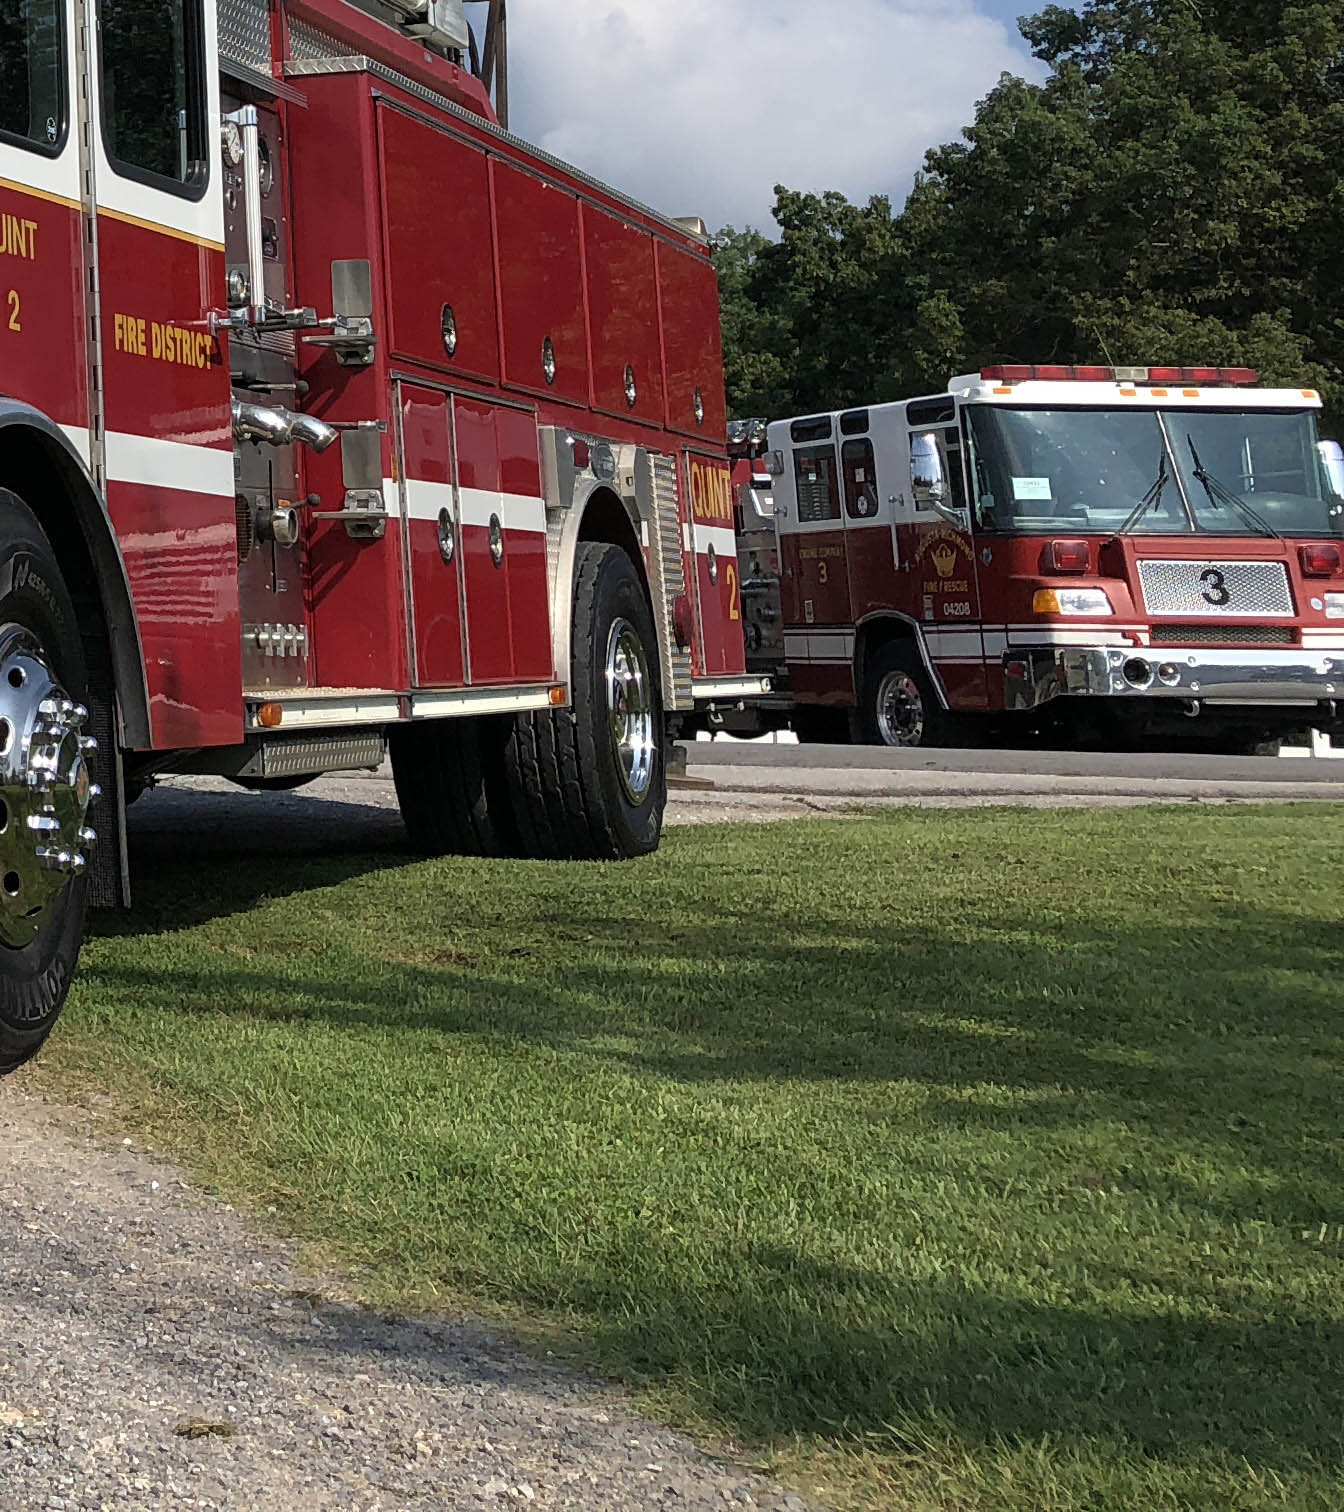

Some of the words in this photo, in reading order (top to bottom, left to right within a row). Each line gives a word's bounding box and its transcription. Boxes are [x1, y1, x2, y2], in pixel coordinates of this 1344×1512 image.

[8, 289, 21, 332] 2
[114, 312, 147, 357] FIRE
[151, 321, 212, 370] DISTRICT
[691, 461, 731, 521] QUINT
[726, 564, 739, 620] 2
[818, 561, 828, 584] 3
[943, 579, 969, 592] RESCUE
[1199, 568, 1230, 606] 3
